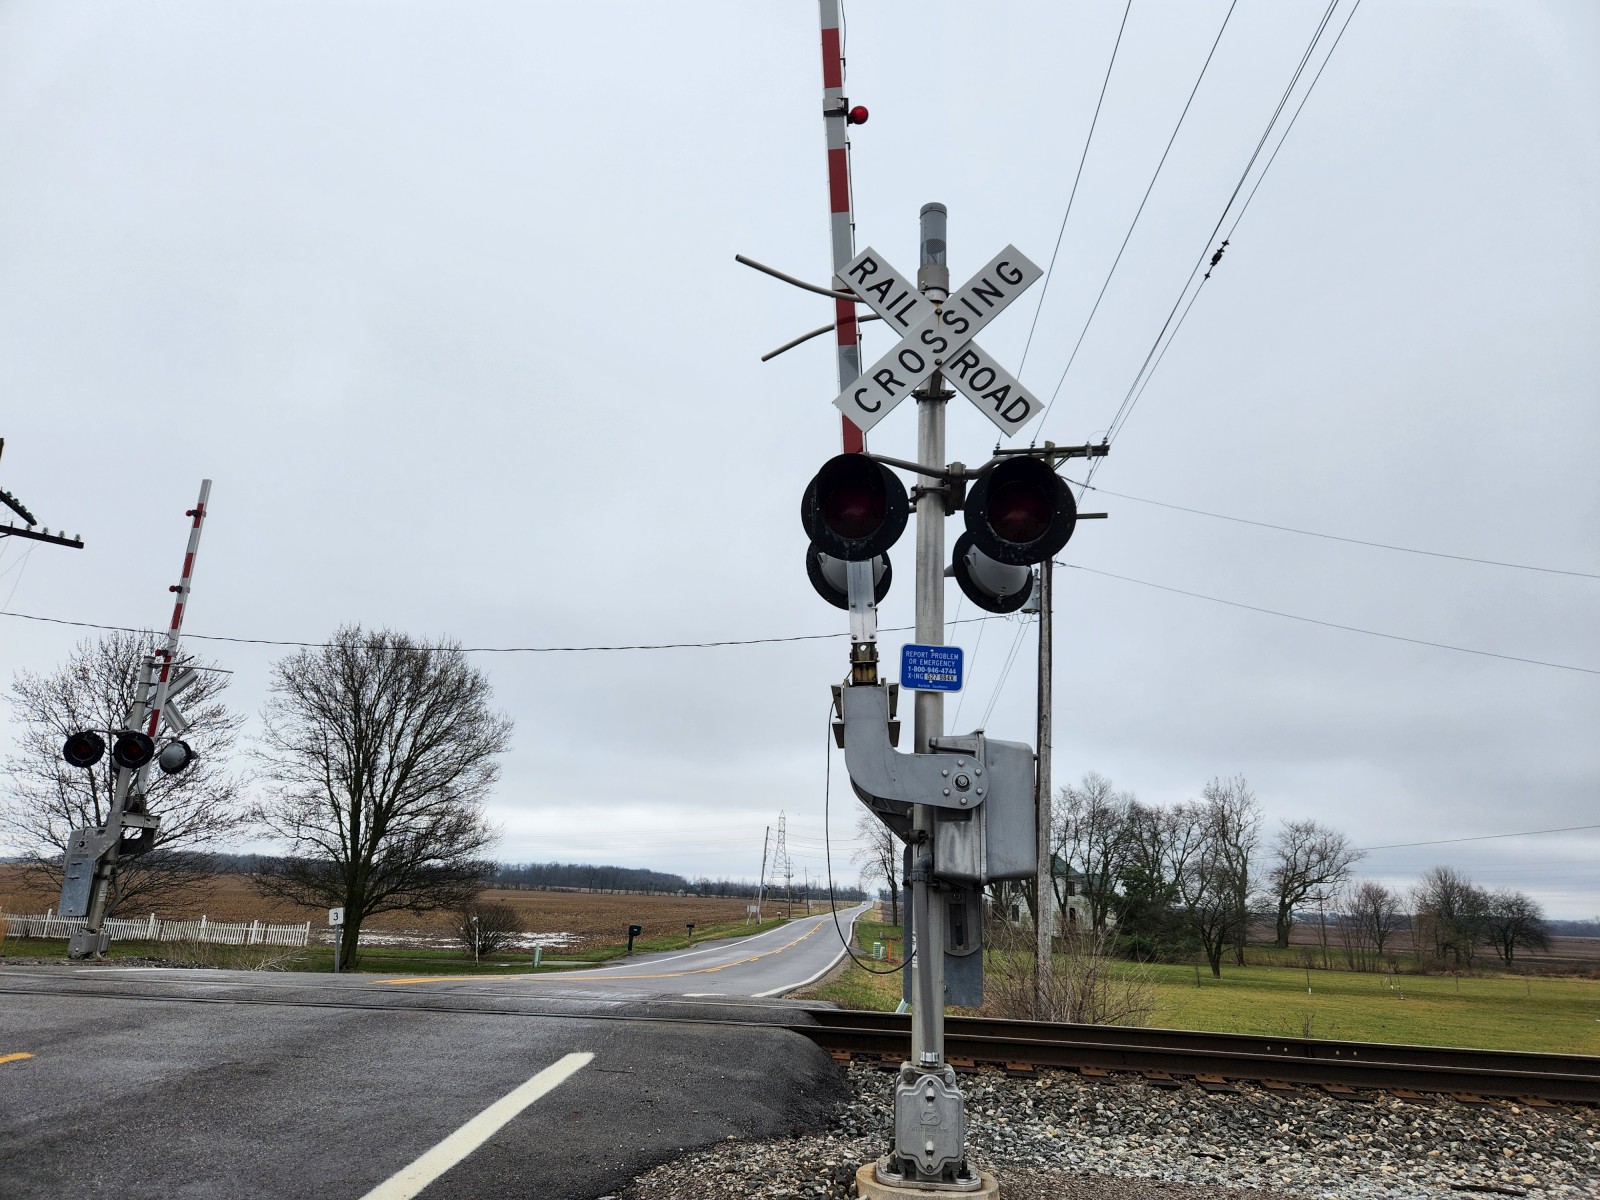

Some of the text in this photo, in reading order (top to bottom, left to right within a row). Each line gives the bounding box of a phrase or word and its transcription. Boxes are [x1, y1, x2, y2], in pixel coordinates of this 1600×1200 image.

[848, 256, 1031, 423] RAIL ROAD
[854, 261, 1024, 413] CROSSING
[908, 666, 956, 674] 1-800-946-4744
[333, 912, 338, 921] 3
